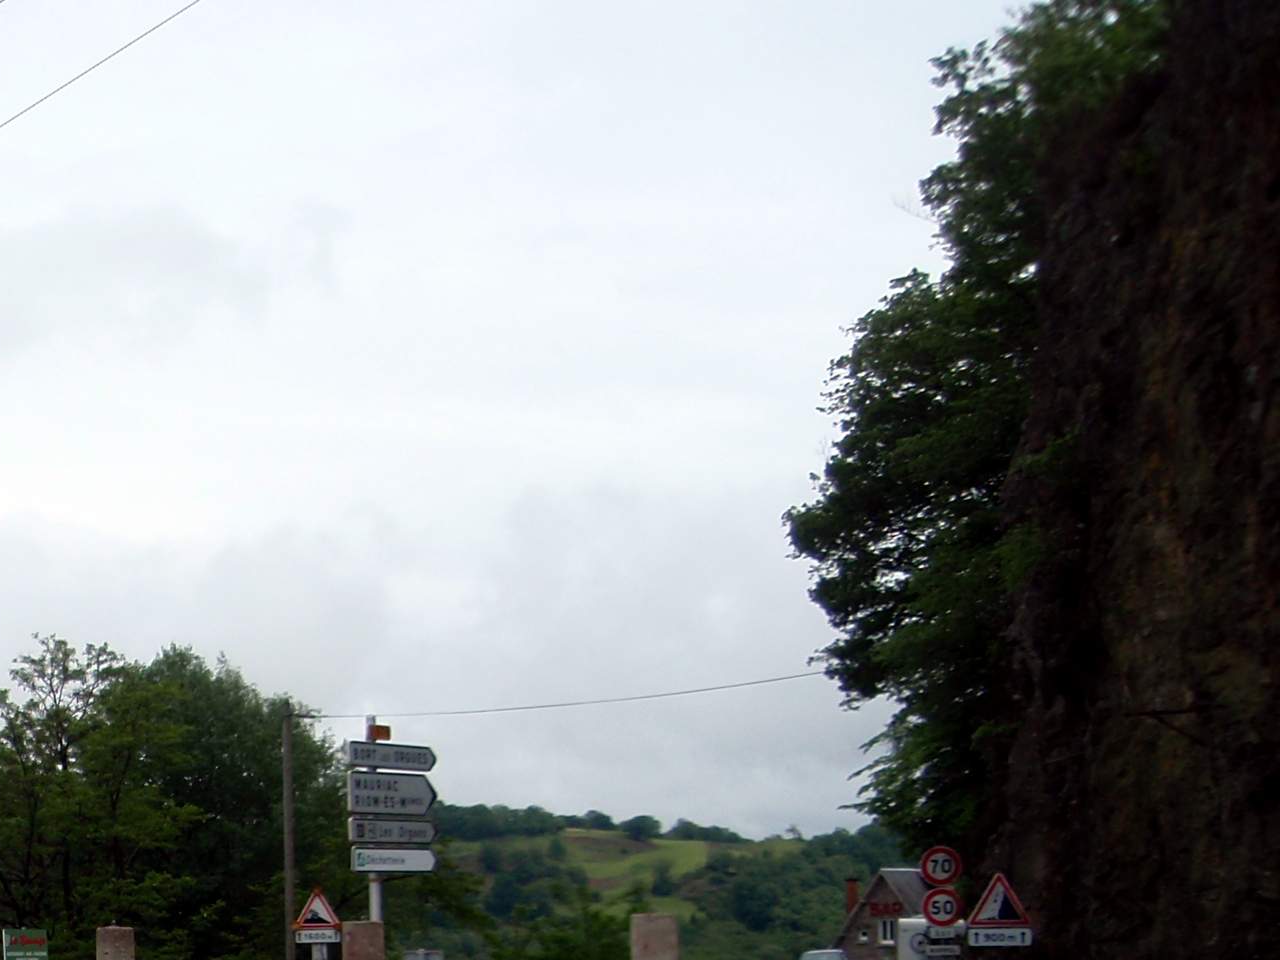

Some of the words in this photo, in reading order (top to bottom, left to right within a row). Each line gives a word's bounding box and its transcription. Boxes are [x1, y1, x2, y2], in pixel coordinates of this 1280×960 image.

[354, 779, 399, 792] MAURIAC
[929, 858, 953, 874] 70
[930, 900, 954, 915] 50
